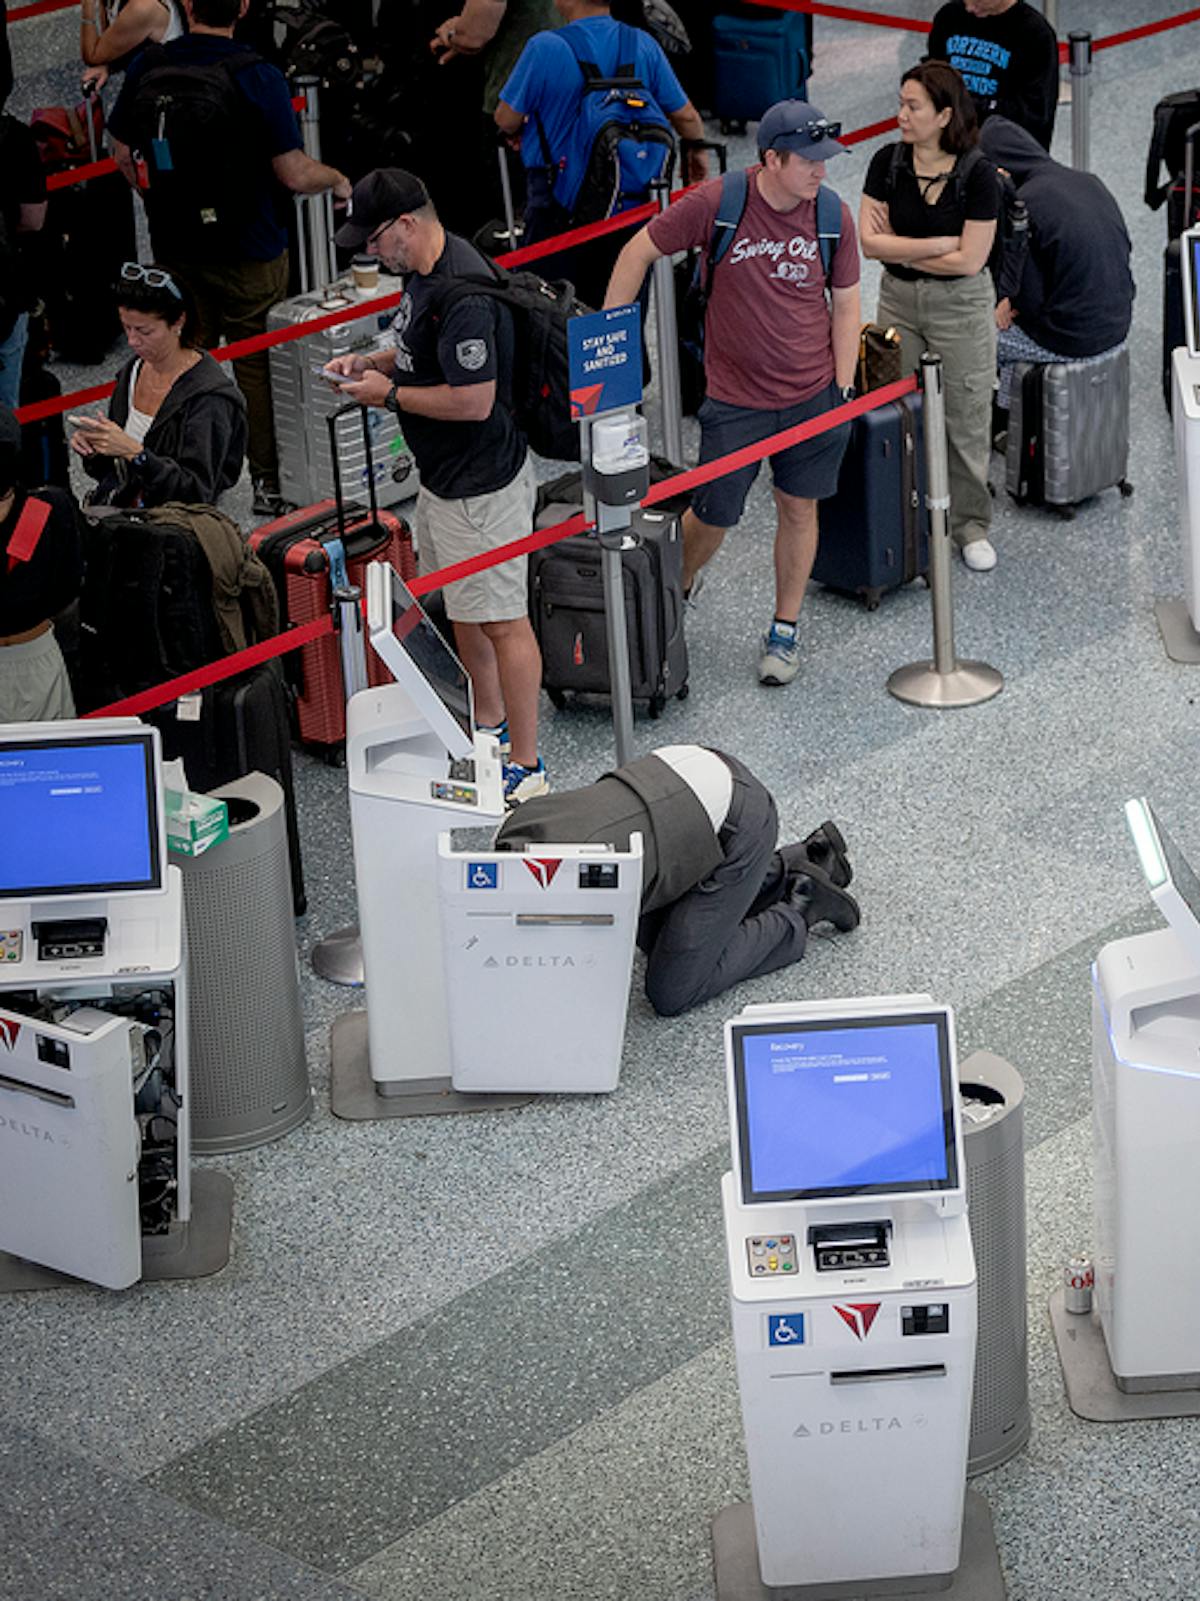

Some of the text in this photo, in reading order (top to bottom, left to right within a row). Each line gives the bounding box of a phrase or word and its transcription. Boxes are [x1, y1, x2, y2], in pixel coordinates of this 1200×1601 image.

[962, 73, 998, 96] ENDS
[730, 238, 785, 264] Swing
[582, 329, 627, 351] STAY SAFE
[596, 344, 615, 357] AND
[583, 352, 627, 373] SANITIZED
[505, 955, 576, 968] DELTA
[820, 1417, 902, 1435] DELTA
